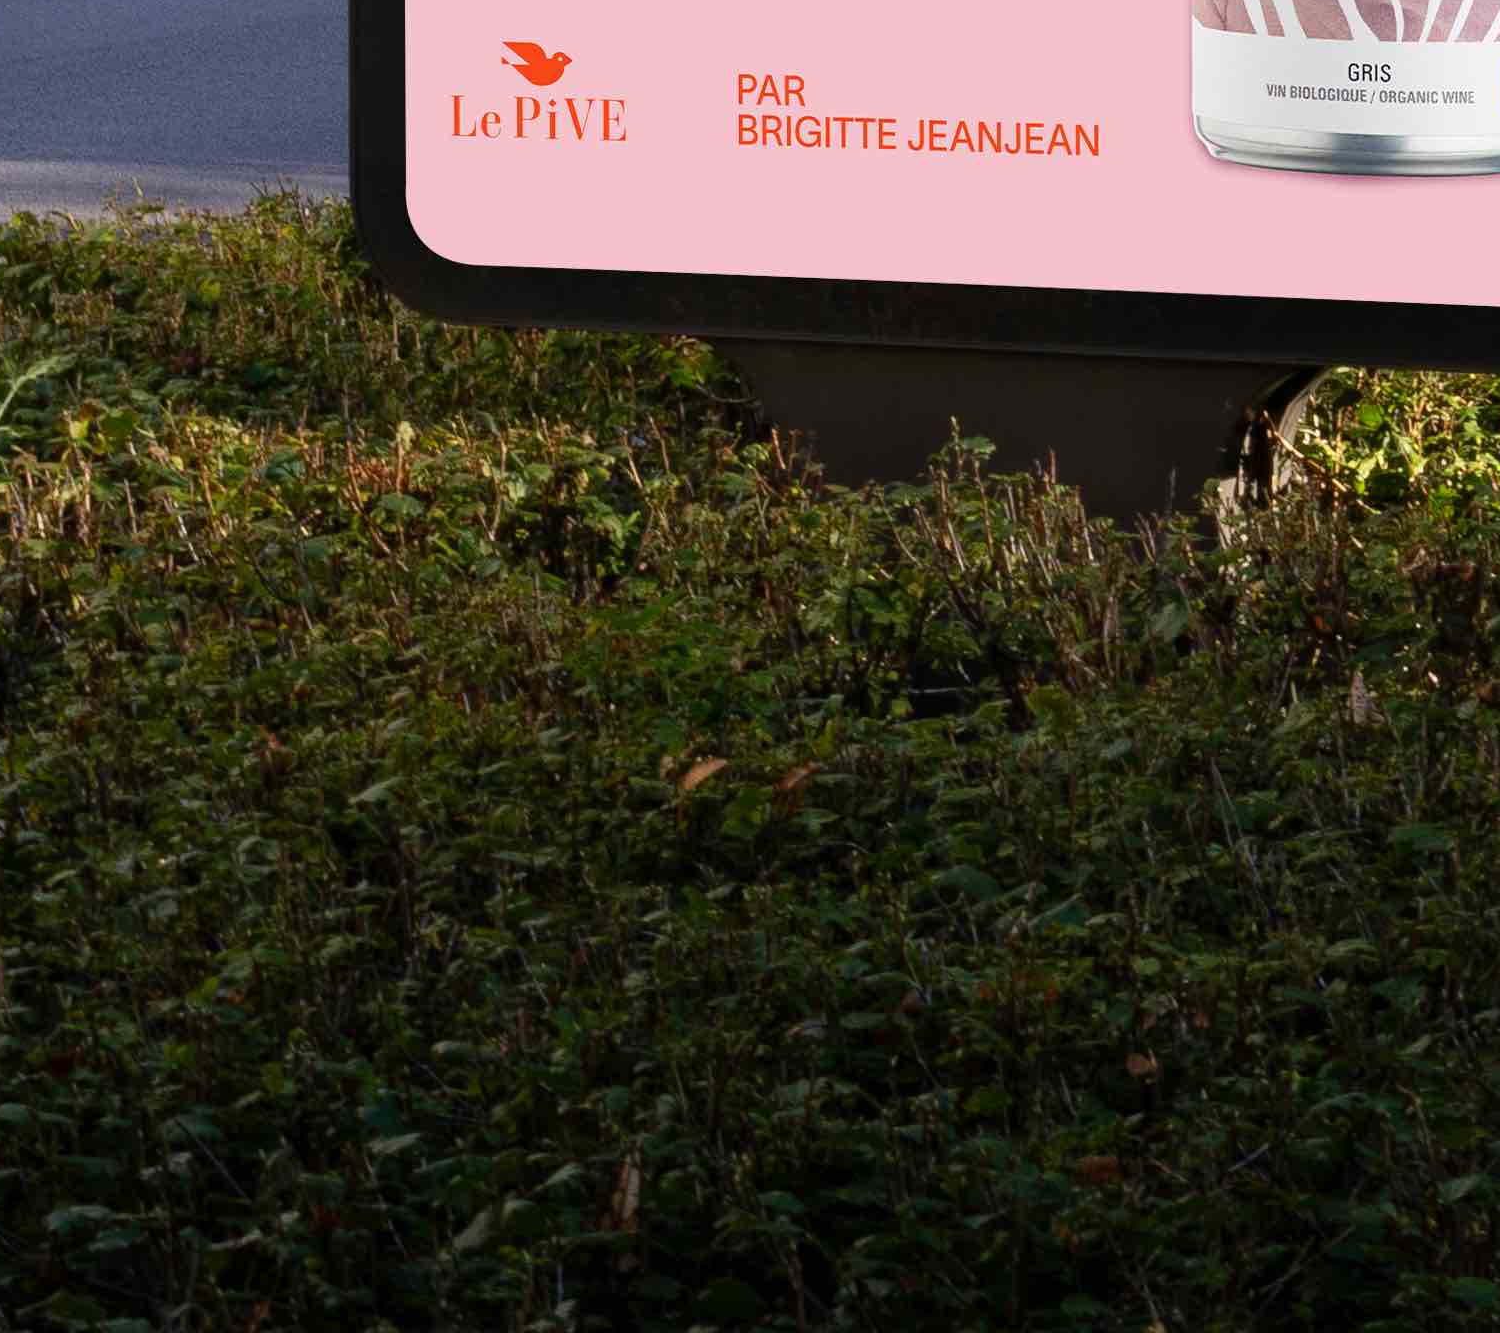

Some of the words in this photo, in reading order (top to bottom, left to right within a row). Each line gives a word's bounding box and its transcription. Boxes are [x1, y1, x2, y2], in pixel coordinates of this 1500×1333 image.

[1347, 62, 1392, 83] GRIS
[737, 73, 806, 107] PAR
[1266, 83, 1287, 99] VIN
[1289, 84, 1368, 103] BIOLOGIQUE
[1378, 89, 1439, 105] ORGANIC
[1441, 90, 1476, 105] WINE
[450, 93, 503, 139] Le
[512, 94, 628, 143] PiVE
[737, 114, 898, 151] BRIGITTE
[906, 118, 1101, 157] JEANJEAN
